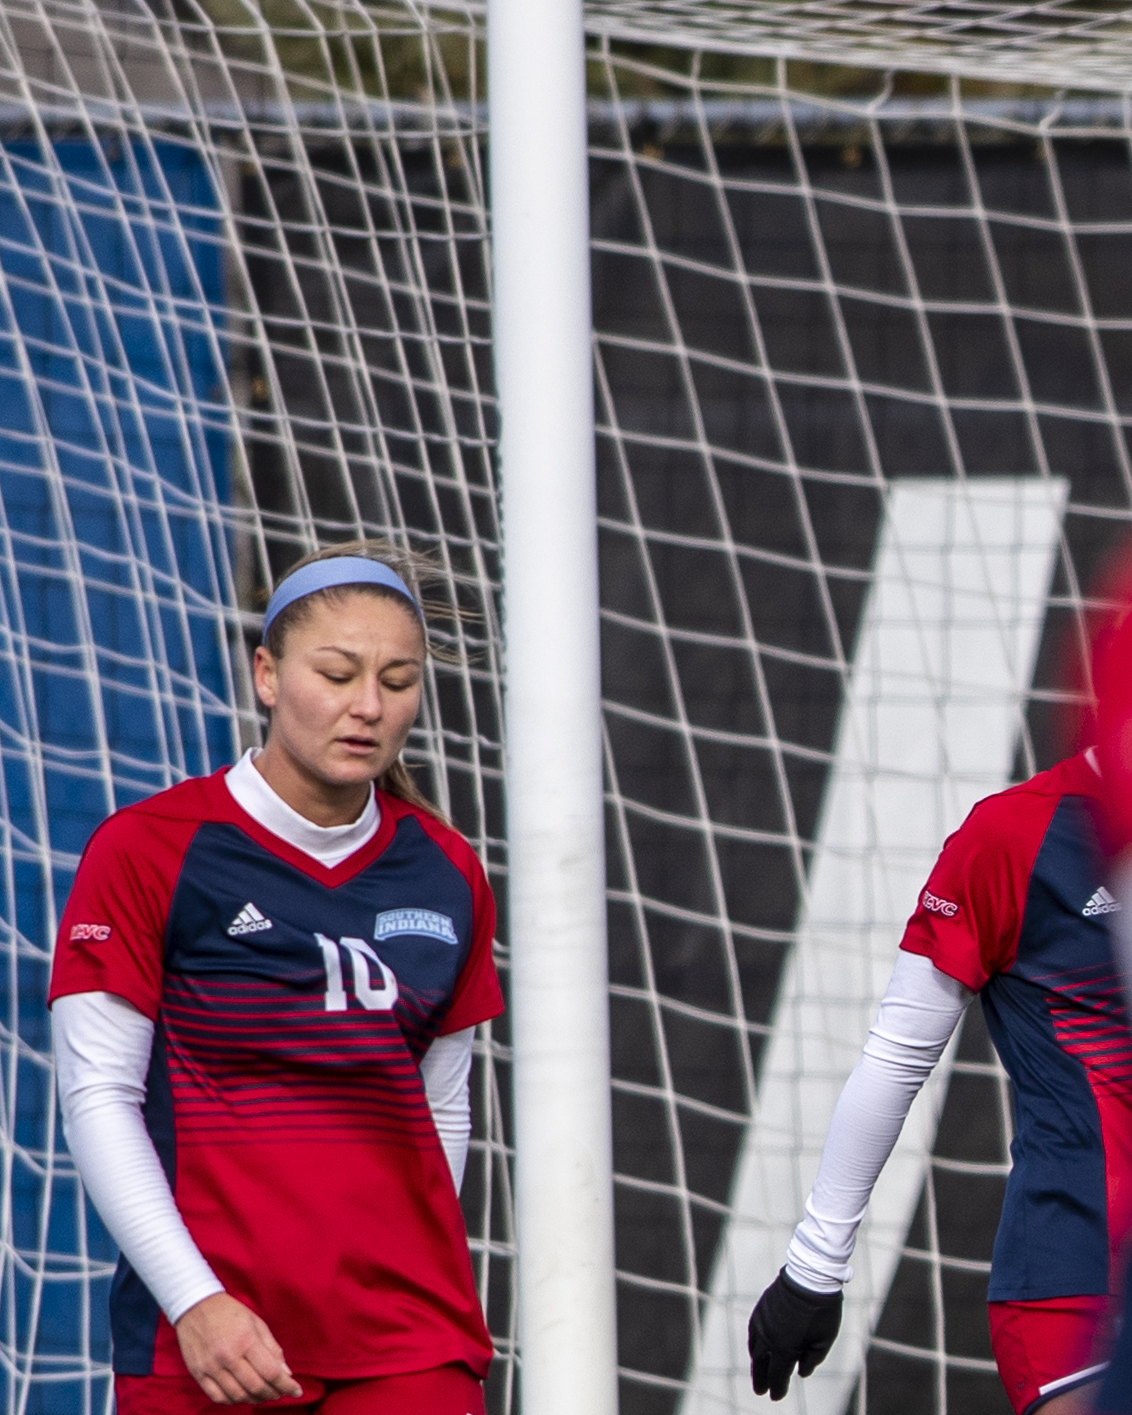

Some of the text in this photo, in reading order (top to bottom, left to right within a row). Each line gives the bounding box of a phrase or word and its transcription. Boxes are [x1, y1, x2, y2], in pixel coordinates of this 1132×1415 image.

[227, 919, 273, 936] adidas
[377, 919, 456, 940] INDIANA
[313, 932, 399, 1012] 10
